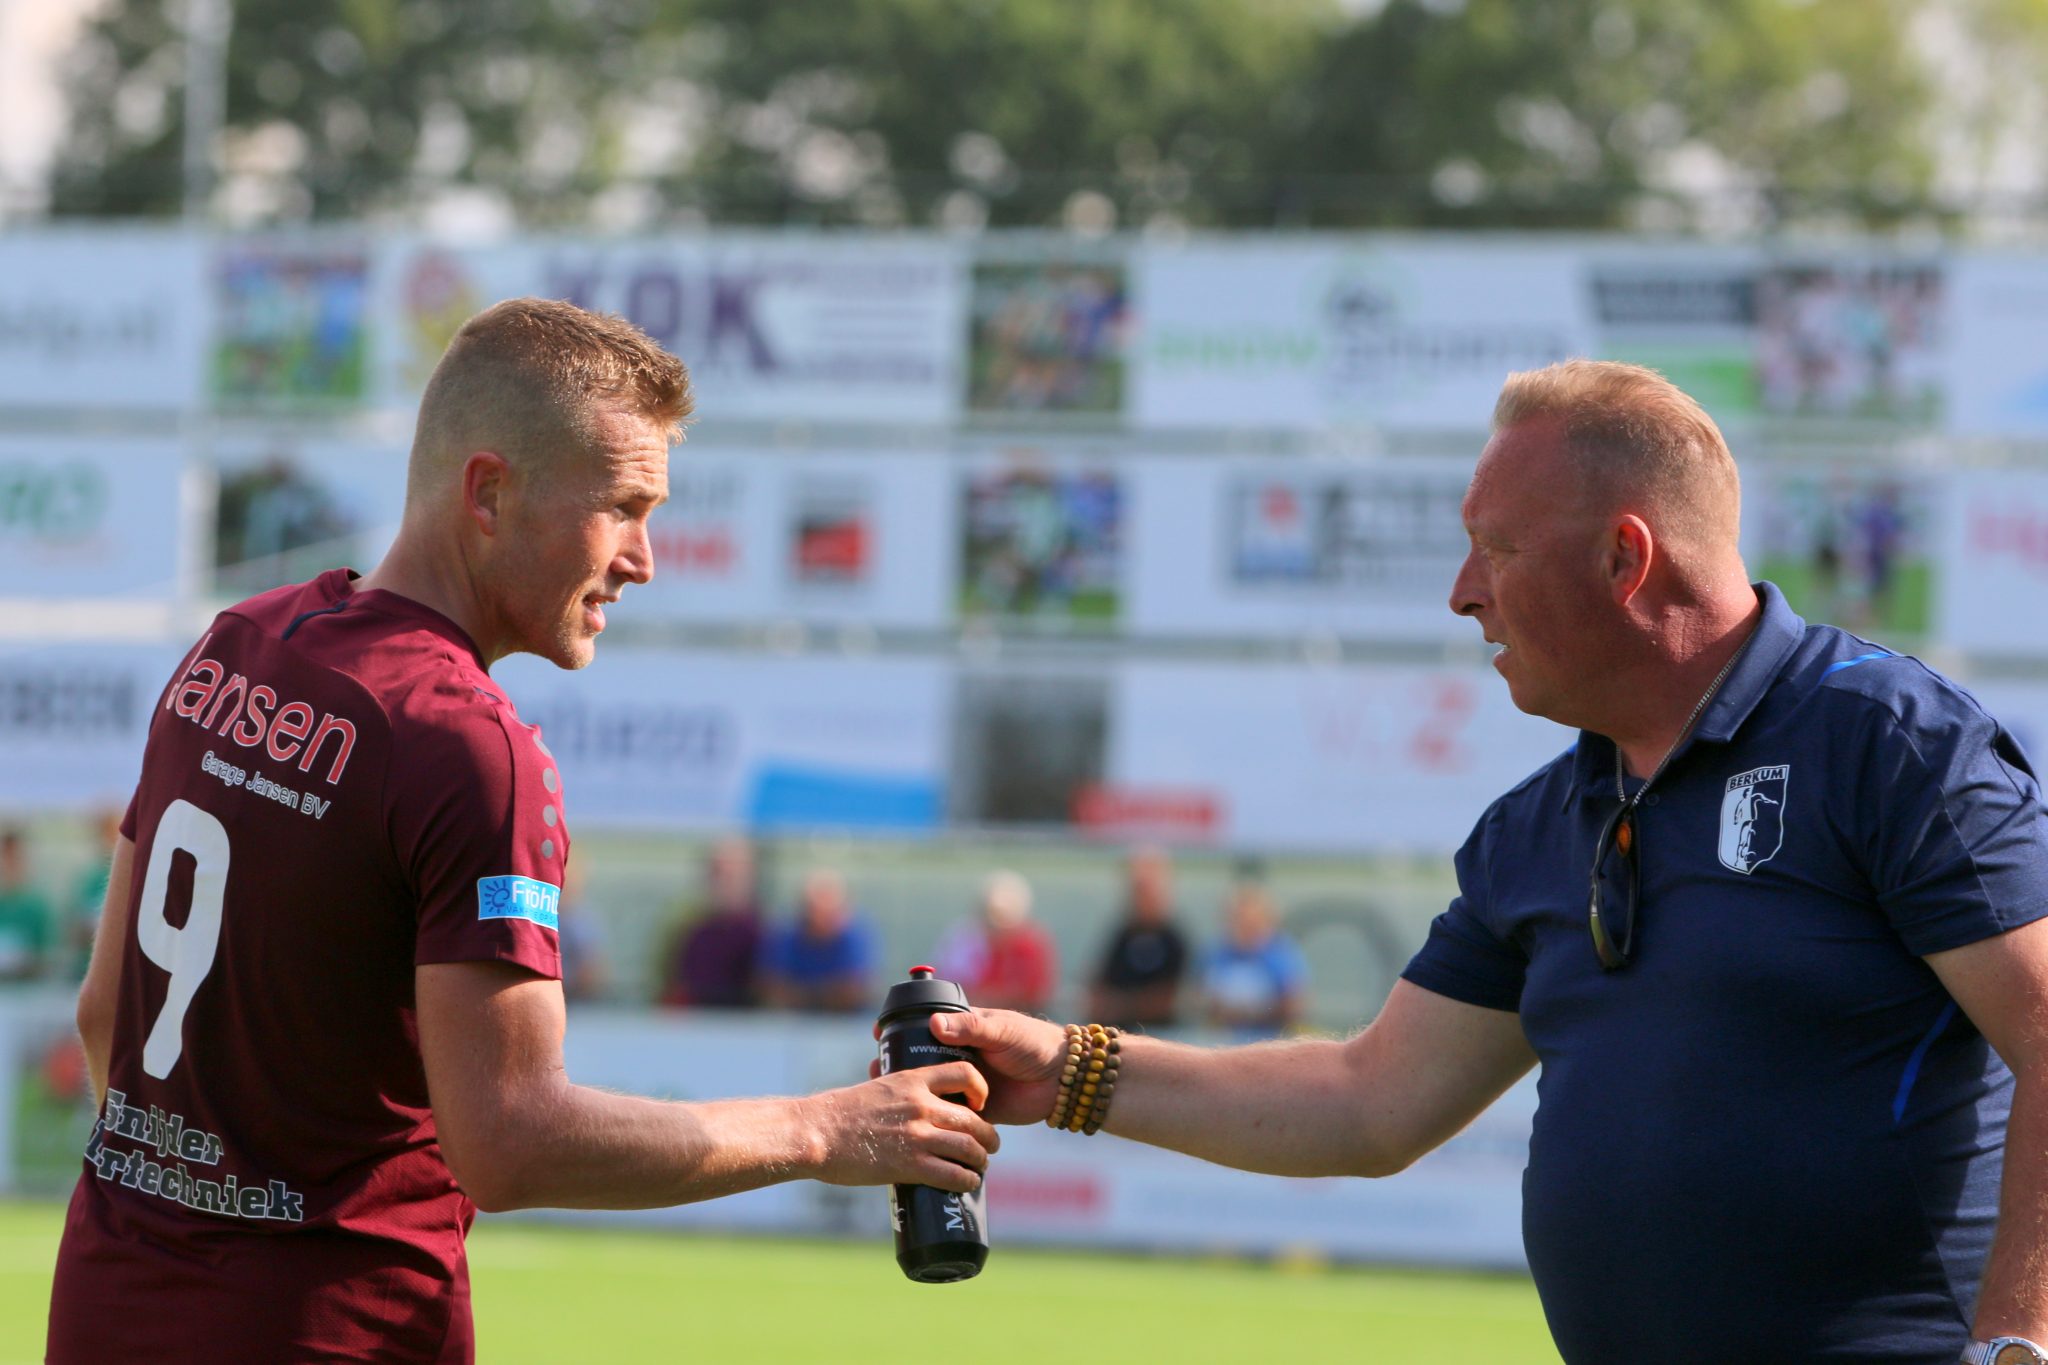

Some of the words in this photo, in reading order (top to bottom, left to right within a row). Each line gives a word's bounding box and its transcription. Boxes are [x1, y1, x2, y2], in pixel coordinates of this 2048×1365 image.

[201, 750, 246, 787] Garage
[246, 771, 299, 809] Jansen
[301, 792, 331, 820] BV
[1729, 768, 1784, 789] BERKUM
[137, 799, 230, 1080] 9
